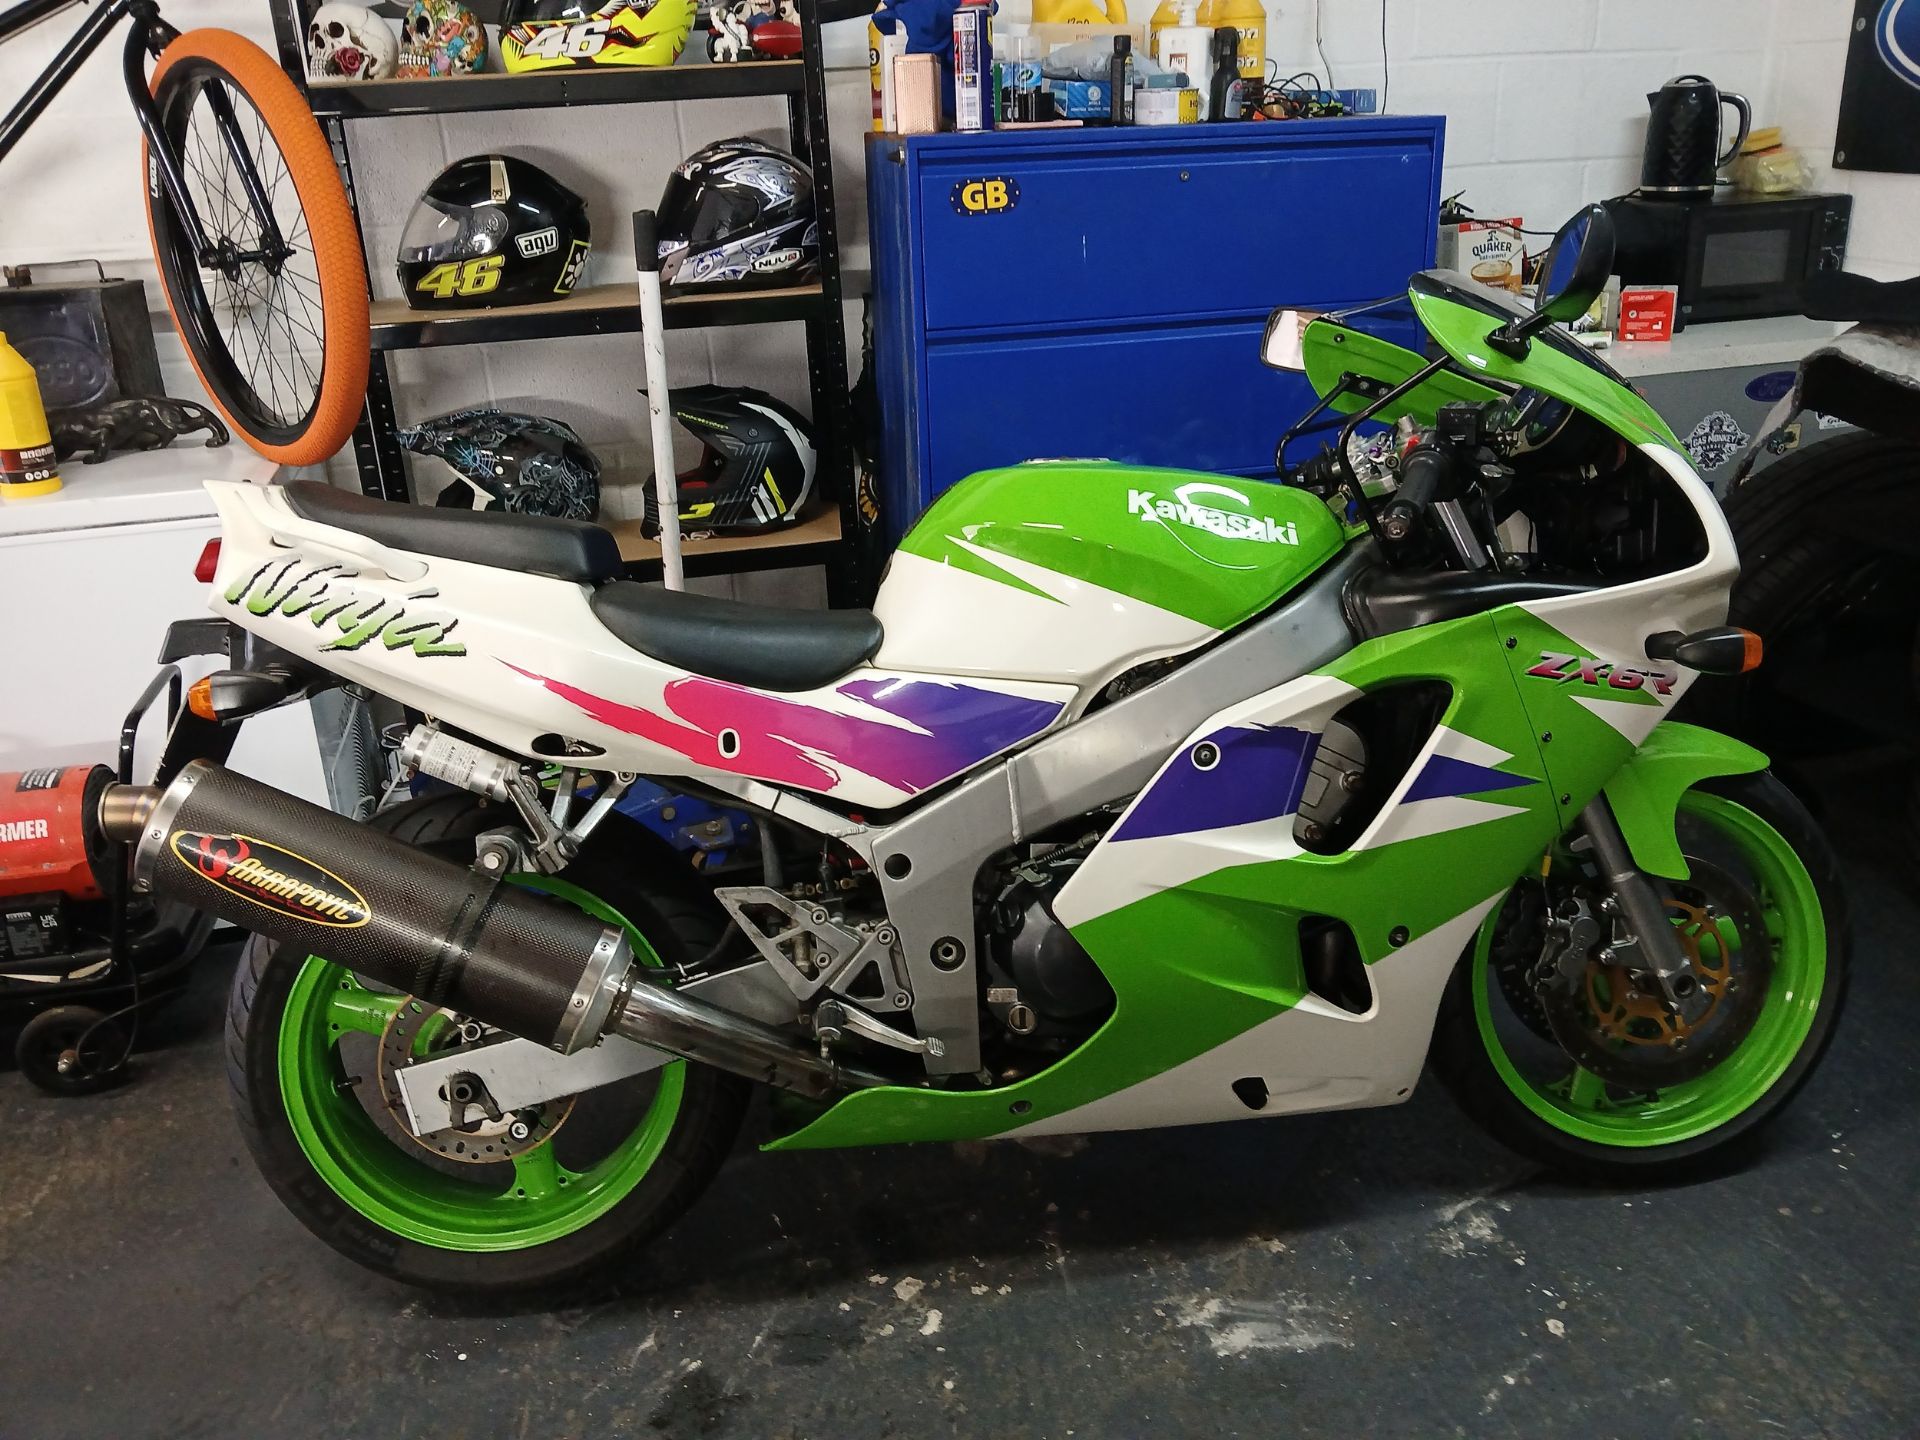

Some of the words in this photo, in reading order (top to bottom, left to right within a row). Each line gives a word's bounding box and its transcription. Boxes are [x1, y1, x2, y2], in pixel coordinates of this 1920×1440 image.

[524, 18, 612, 60] 46
[961, 180, 1009, 211] GB
[523, 231, 555, 255] agv
[1472, 241, 1512, 257] QUAKER
[416, 254, 505, 298] 46
[1691, 434, 1708, 448] GAS
[1708, 432, 1737, 444] MONKEY
[1128, 489, 1299, 545] Kawasaki
[223, 555, 467, 657] Ninja
[1525, 650, 1678, 696] ZX-6R
